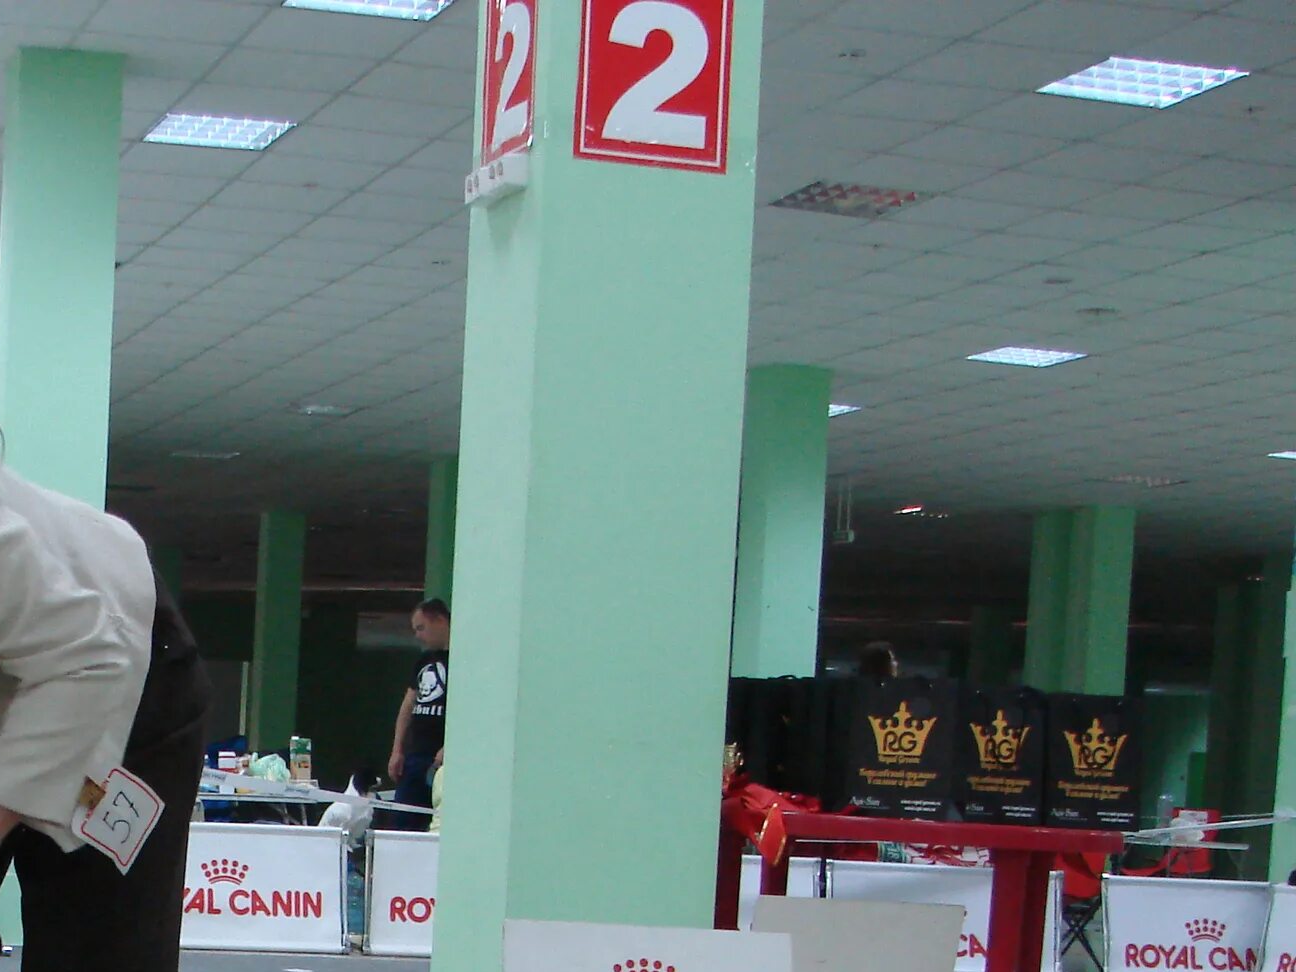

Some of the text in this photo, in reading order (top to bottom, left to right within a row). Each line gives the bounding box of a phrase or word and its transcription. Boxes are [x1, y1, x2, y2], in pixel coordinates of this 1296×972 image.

[492, 1, 532, 152] 2
[602, 1, 709, 149] 2
[102, 790, 141, 845] 57
[228, 889, 323, 918] CANIN
[1124, 943, 1203, 971] ROYAL
